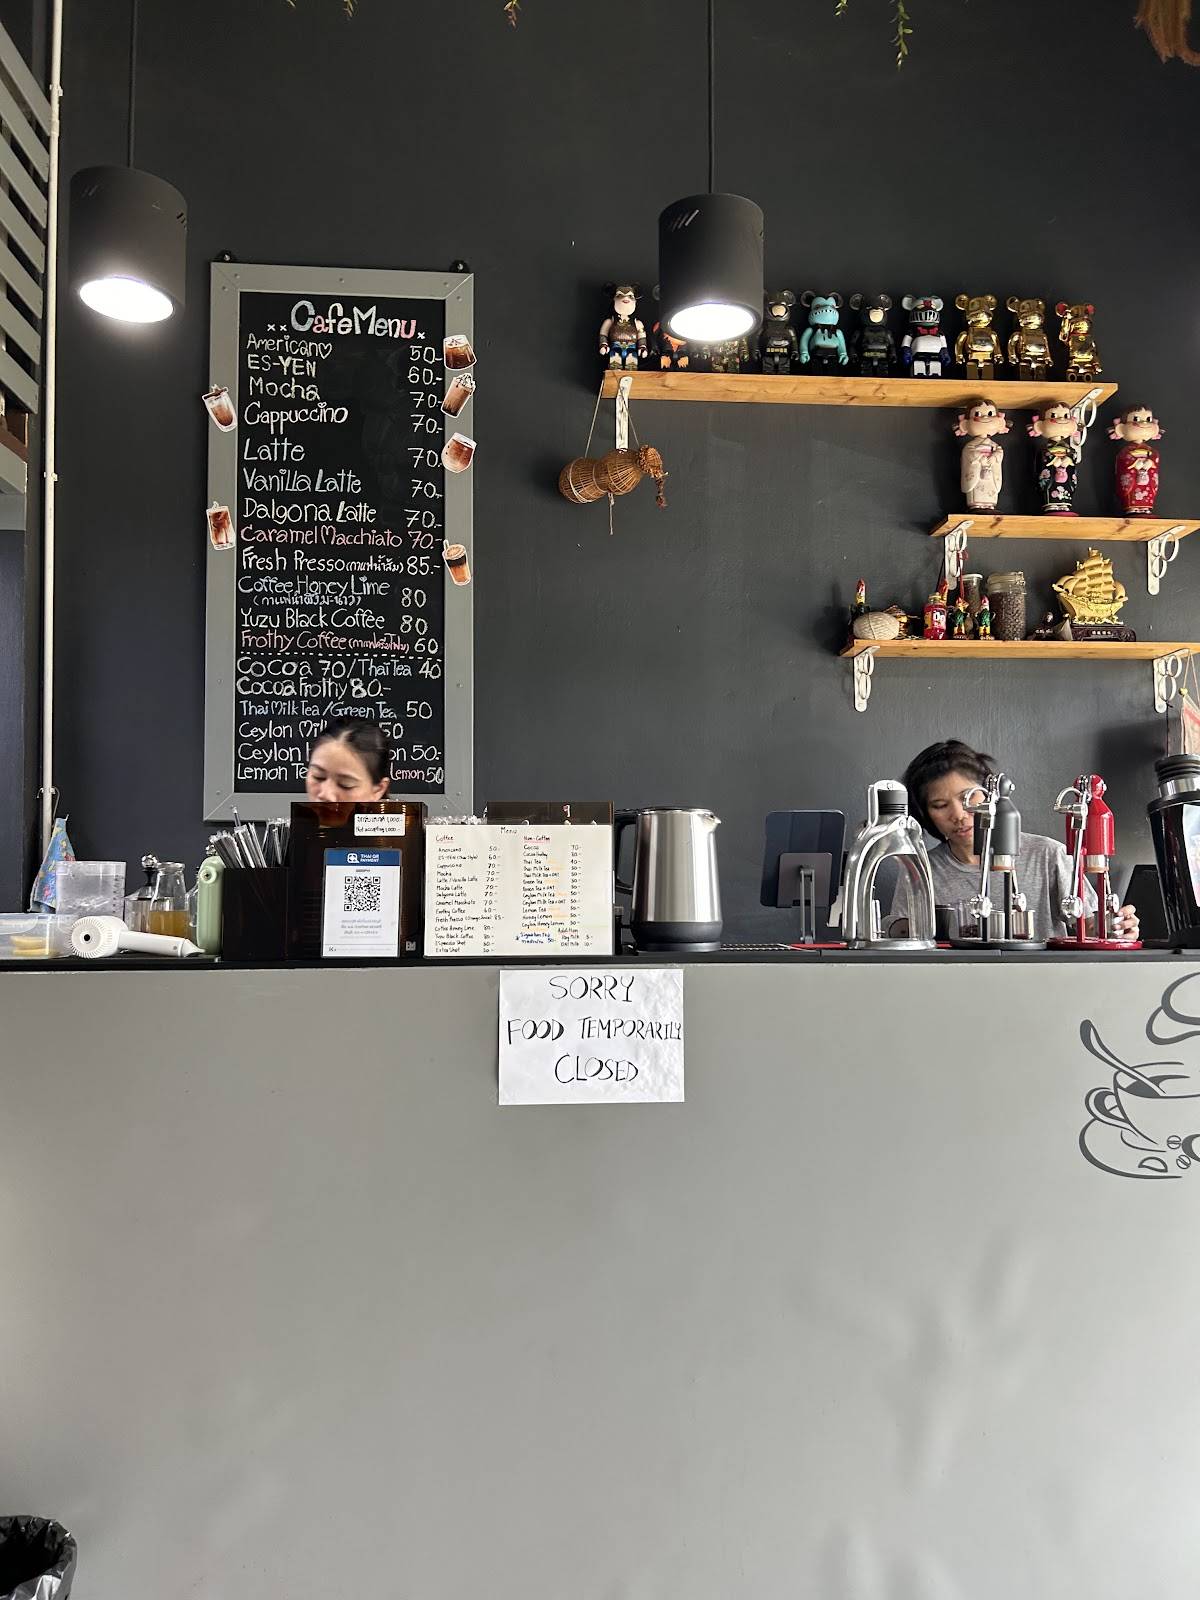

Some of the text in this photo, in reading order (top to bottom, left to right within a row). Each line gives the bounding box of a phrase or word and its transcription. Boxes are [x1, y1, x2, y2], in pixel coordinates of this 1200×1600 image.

[248, 354, 316, 378] ES-YEN
[249, 376, 320, 401] Mocha
[244, 401, 348, 434] Cappuccino
[244, 438, 305, 461] Latte
[243, 468, 311, 492] Vanilla
[315, 469, 361, 493] Latte
[243, 498, 333, 524] Dalgona
[337, 501, 376, 522] Latte
[241, 524, 317, 543] Caramel
[321, 525, 402, 547] Macchiato
[242, 546, 287, 570] Fresh
[294, 550, 345, 571] Presso
[238, 575, 426, 607] Coffee Honey Lime 80
[241, 606, 427, 634] Yuzu Black Coffee 80
[242, 629, 294, 652] Frothy
[297, 630, 347, 649] Coffee
[414, 638, 438, 654] 60
[237, 657, 313, 677] Cocoa
[390, 659, 412, 676] Tea
[419, 659, 441, 679] 40
[236, 676, 296, 696] Cocoa
[299, 677, 347, 700] Frothy
[240, 701, 269, 716] Thai
[271, 701, 298, 717] Milk
[301, 701, 320, 716] Tea
[376, 701, 397, 719] Tea
[406, 701, 432, 719] 50
[239, 720, 292, 742] Ceylon
[299, 720, 327, 737] Mil
[238, 742, 301, 764] Ceylon
[237, 764, 287, 781] Lemon
[291, 763, 308, 779] Te
[425, 767, 443, 784] 50
[549, 975, 634, 1002] SORRY
[508, 1016, 681, 1044] FOOD TEMPORARILY
[555, 1053, 638, 1083] CLOSED
